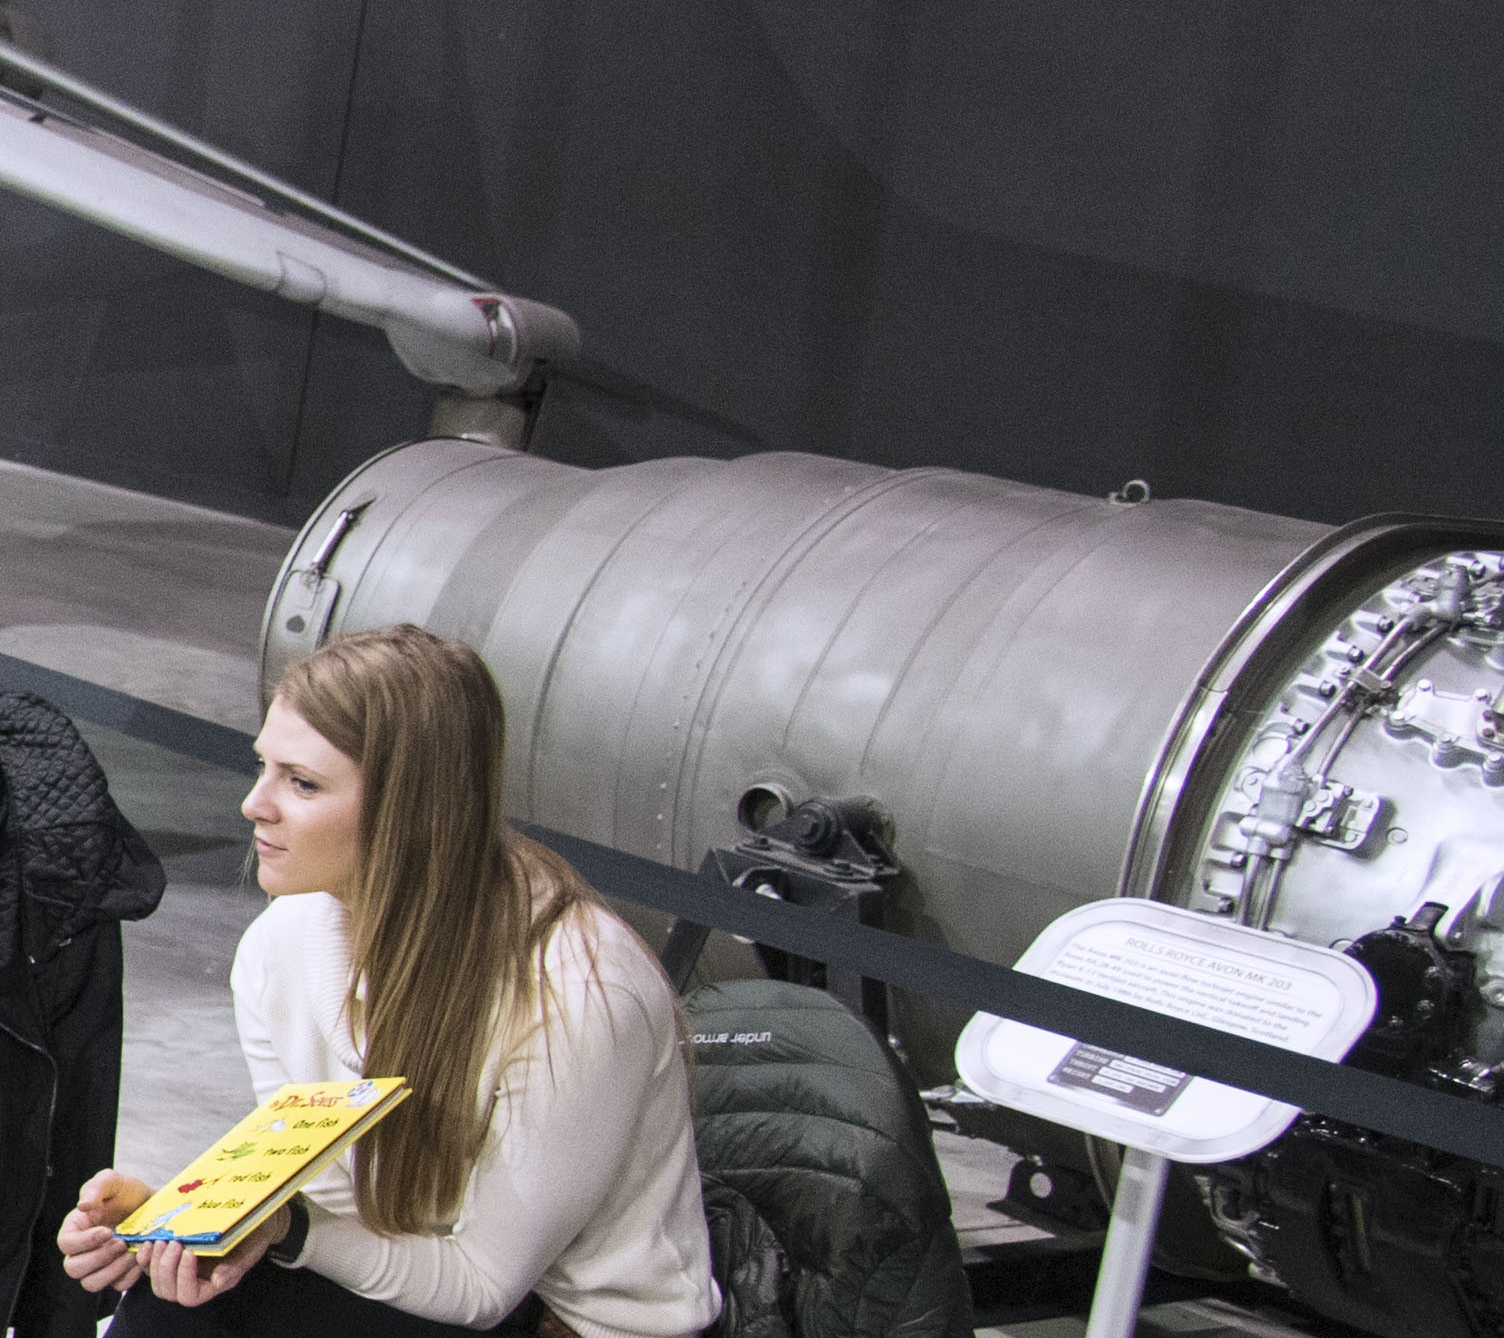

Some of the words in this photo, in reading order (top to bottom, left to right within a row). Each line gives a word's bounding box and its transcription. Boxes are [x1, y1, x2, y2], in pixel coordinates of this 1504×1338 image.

[1125, 937, 1165, 956] ROLLS
[1166, 948, 1206, 967] ROYCE
[1207, 959, 1244, 977] AVON
[1245, 970, 1268, 984] MK
[1268, 975, 1292, 991] 203
[730, 1031, 772, 1045] under
